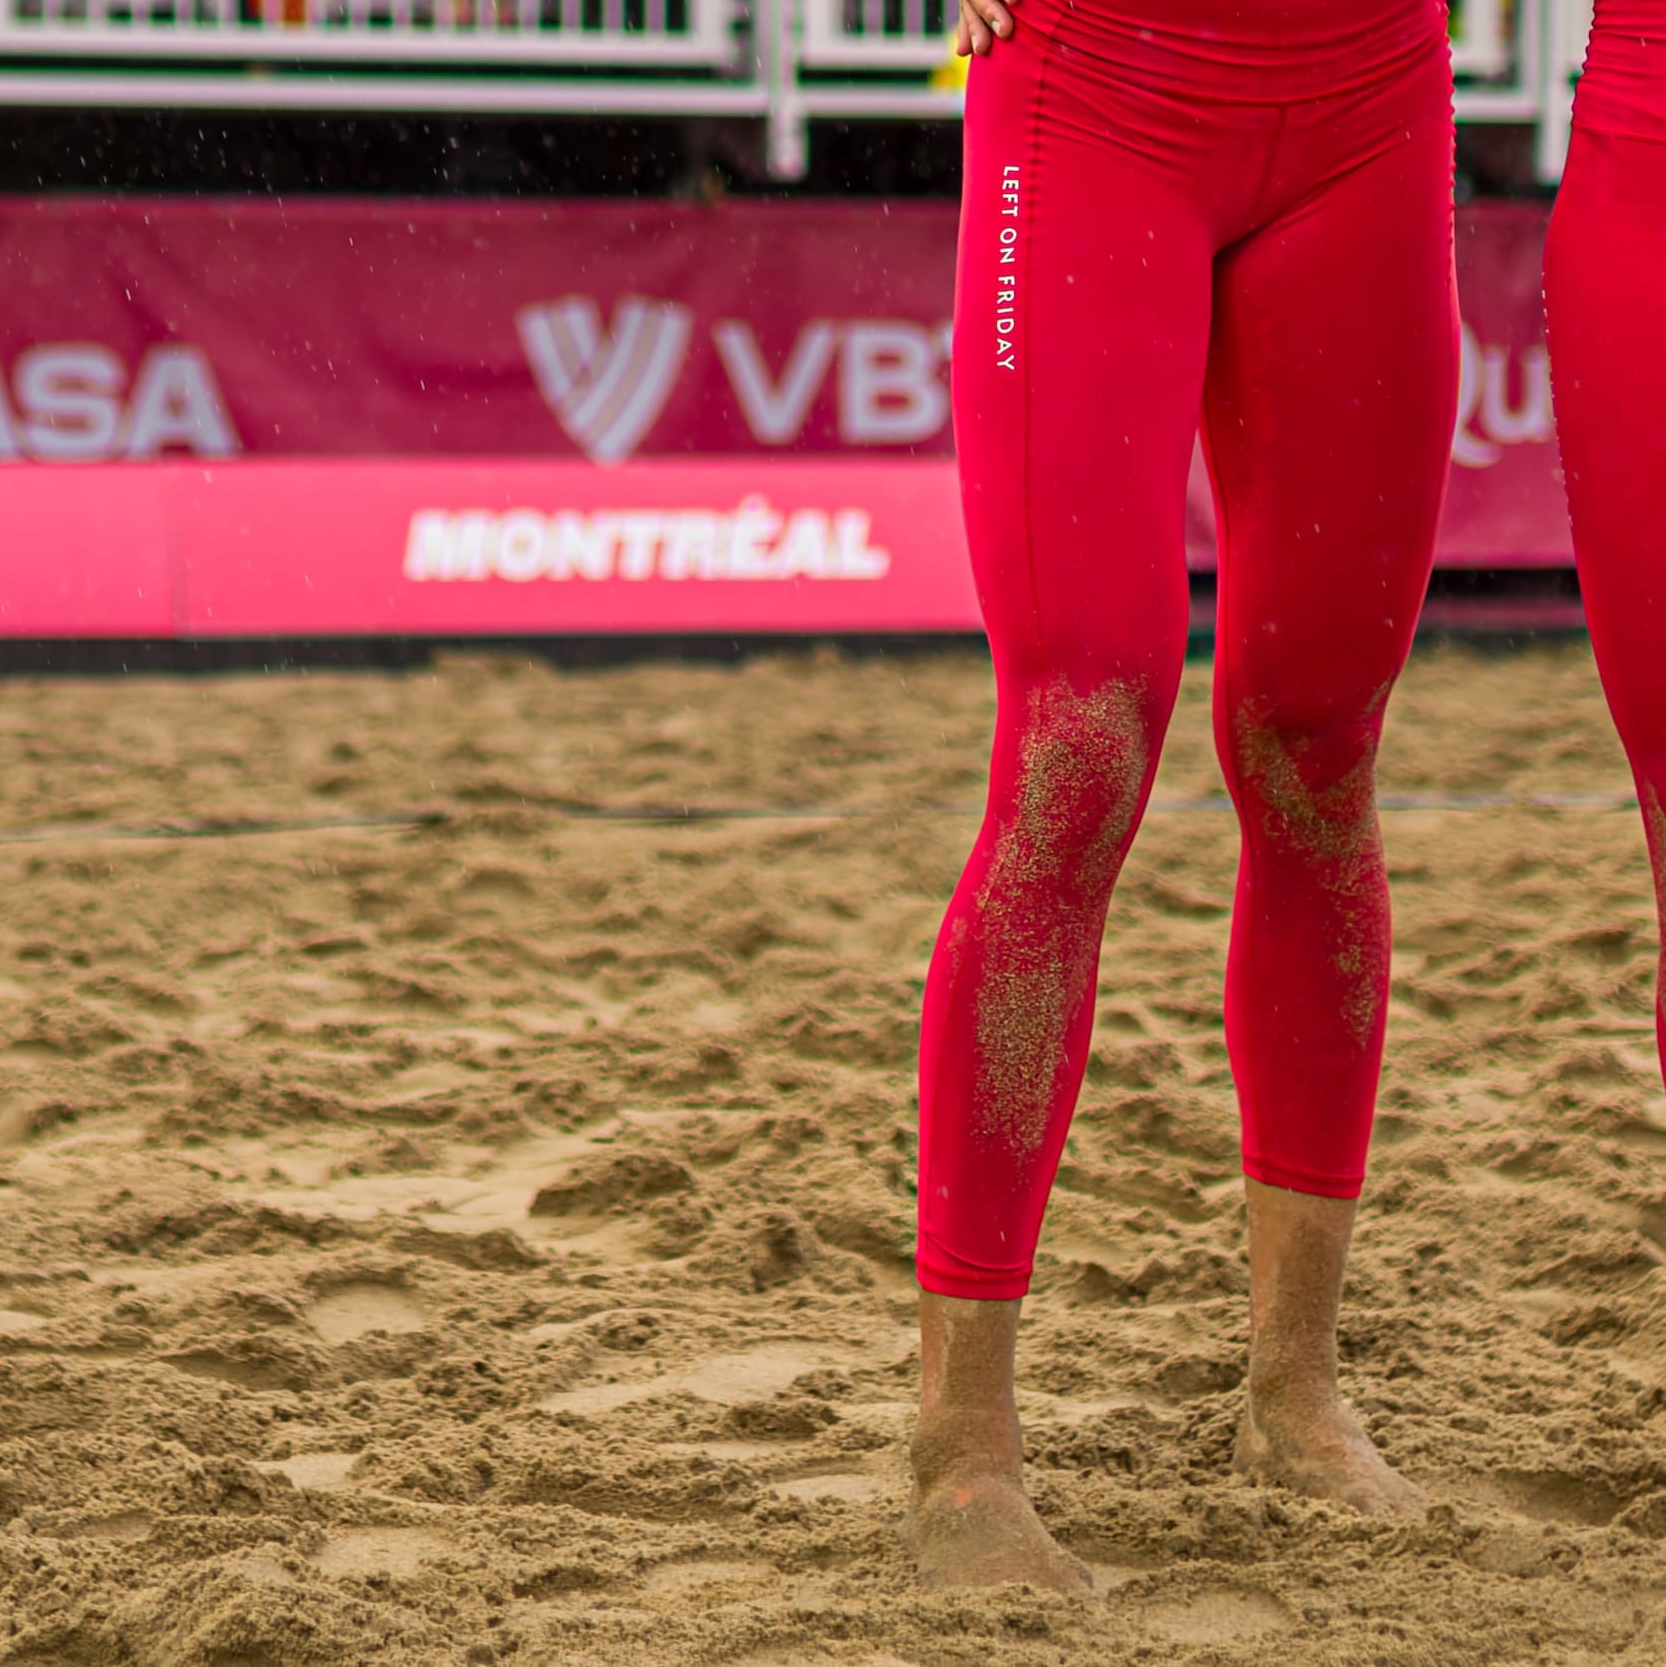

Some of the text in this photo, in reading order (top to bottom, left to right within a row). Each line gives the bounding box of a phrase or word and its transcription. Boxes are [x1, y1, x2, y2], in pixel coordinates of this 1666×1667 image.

[995, 166, 1020, 371] LEFT ON FRIDAY
[402, 492, 892, 582] MONTRÉAL
